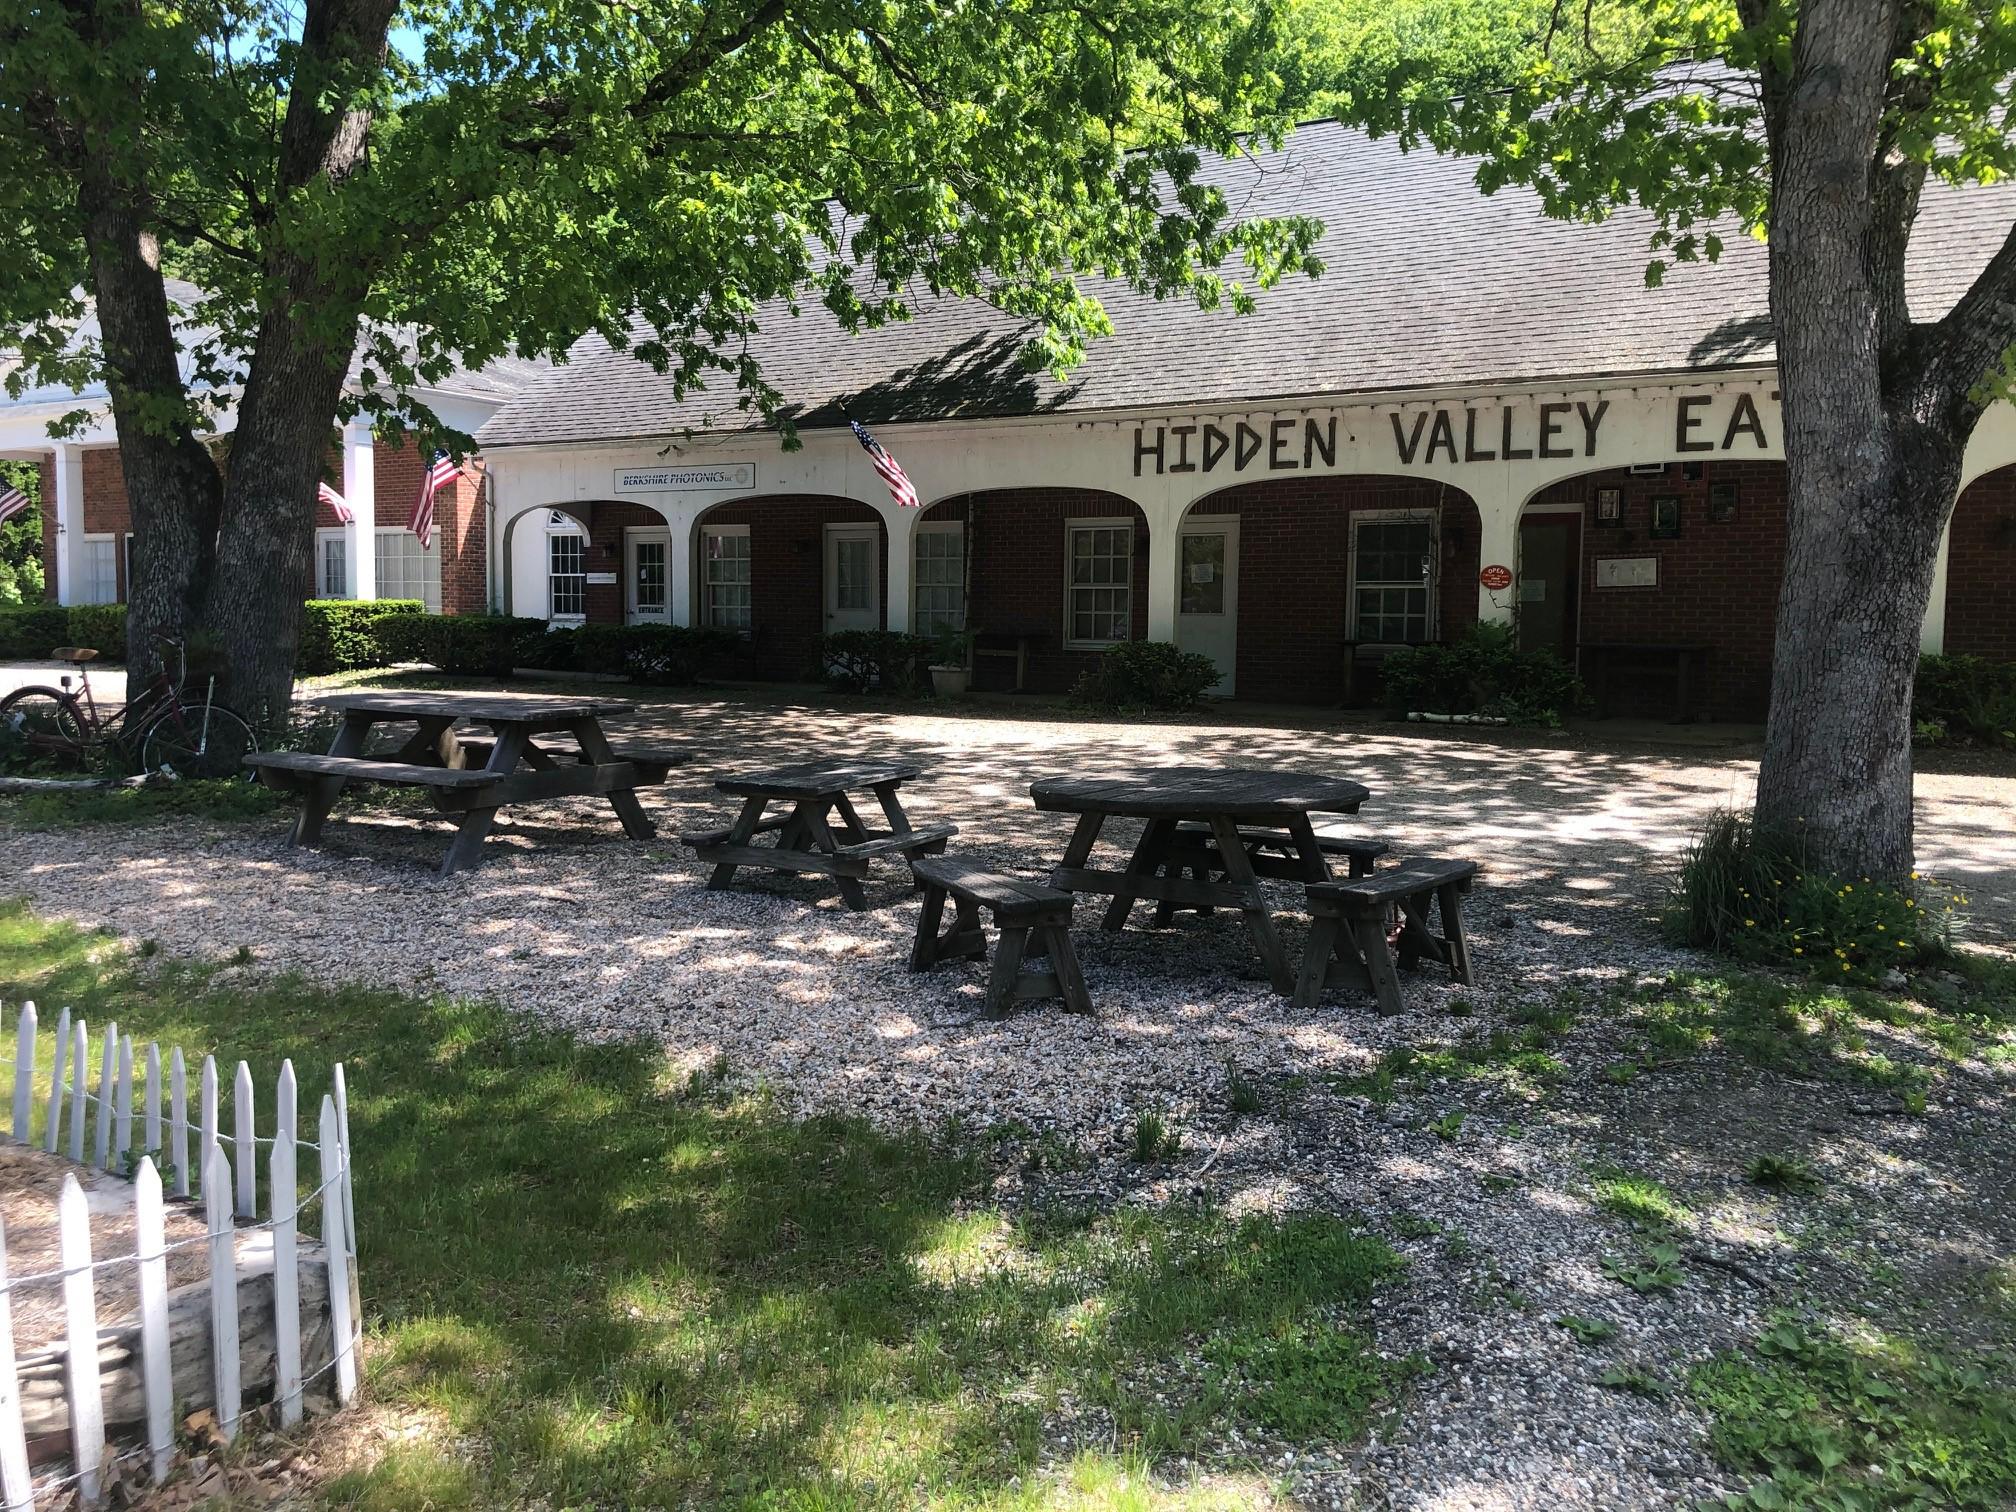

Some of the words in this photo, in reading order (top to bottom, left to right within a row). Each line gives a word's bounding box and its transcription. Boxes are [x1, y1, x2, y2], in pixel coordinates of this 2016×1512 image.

[1133, 416, 1337, 477] HIDDEN
[1390, 400, 1610, 465] VALLEY
[1676, 390, 1781, 453] EA
[623, 474, 669, 485] BERKSHIRE
[670, 471, 725, 484] PHOTONICS
